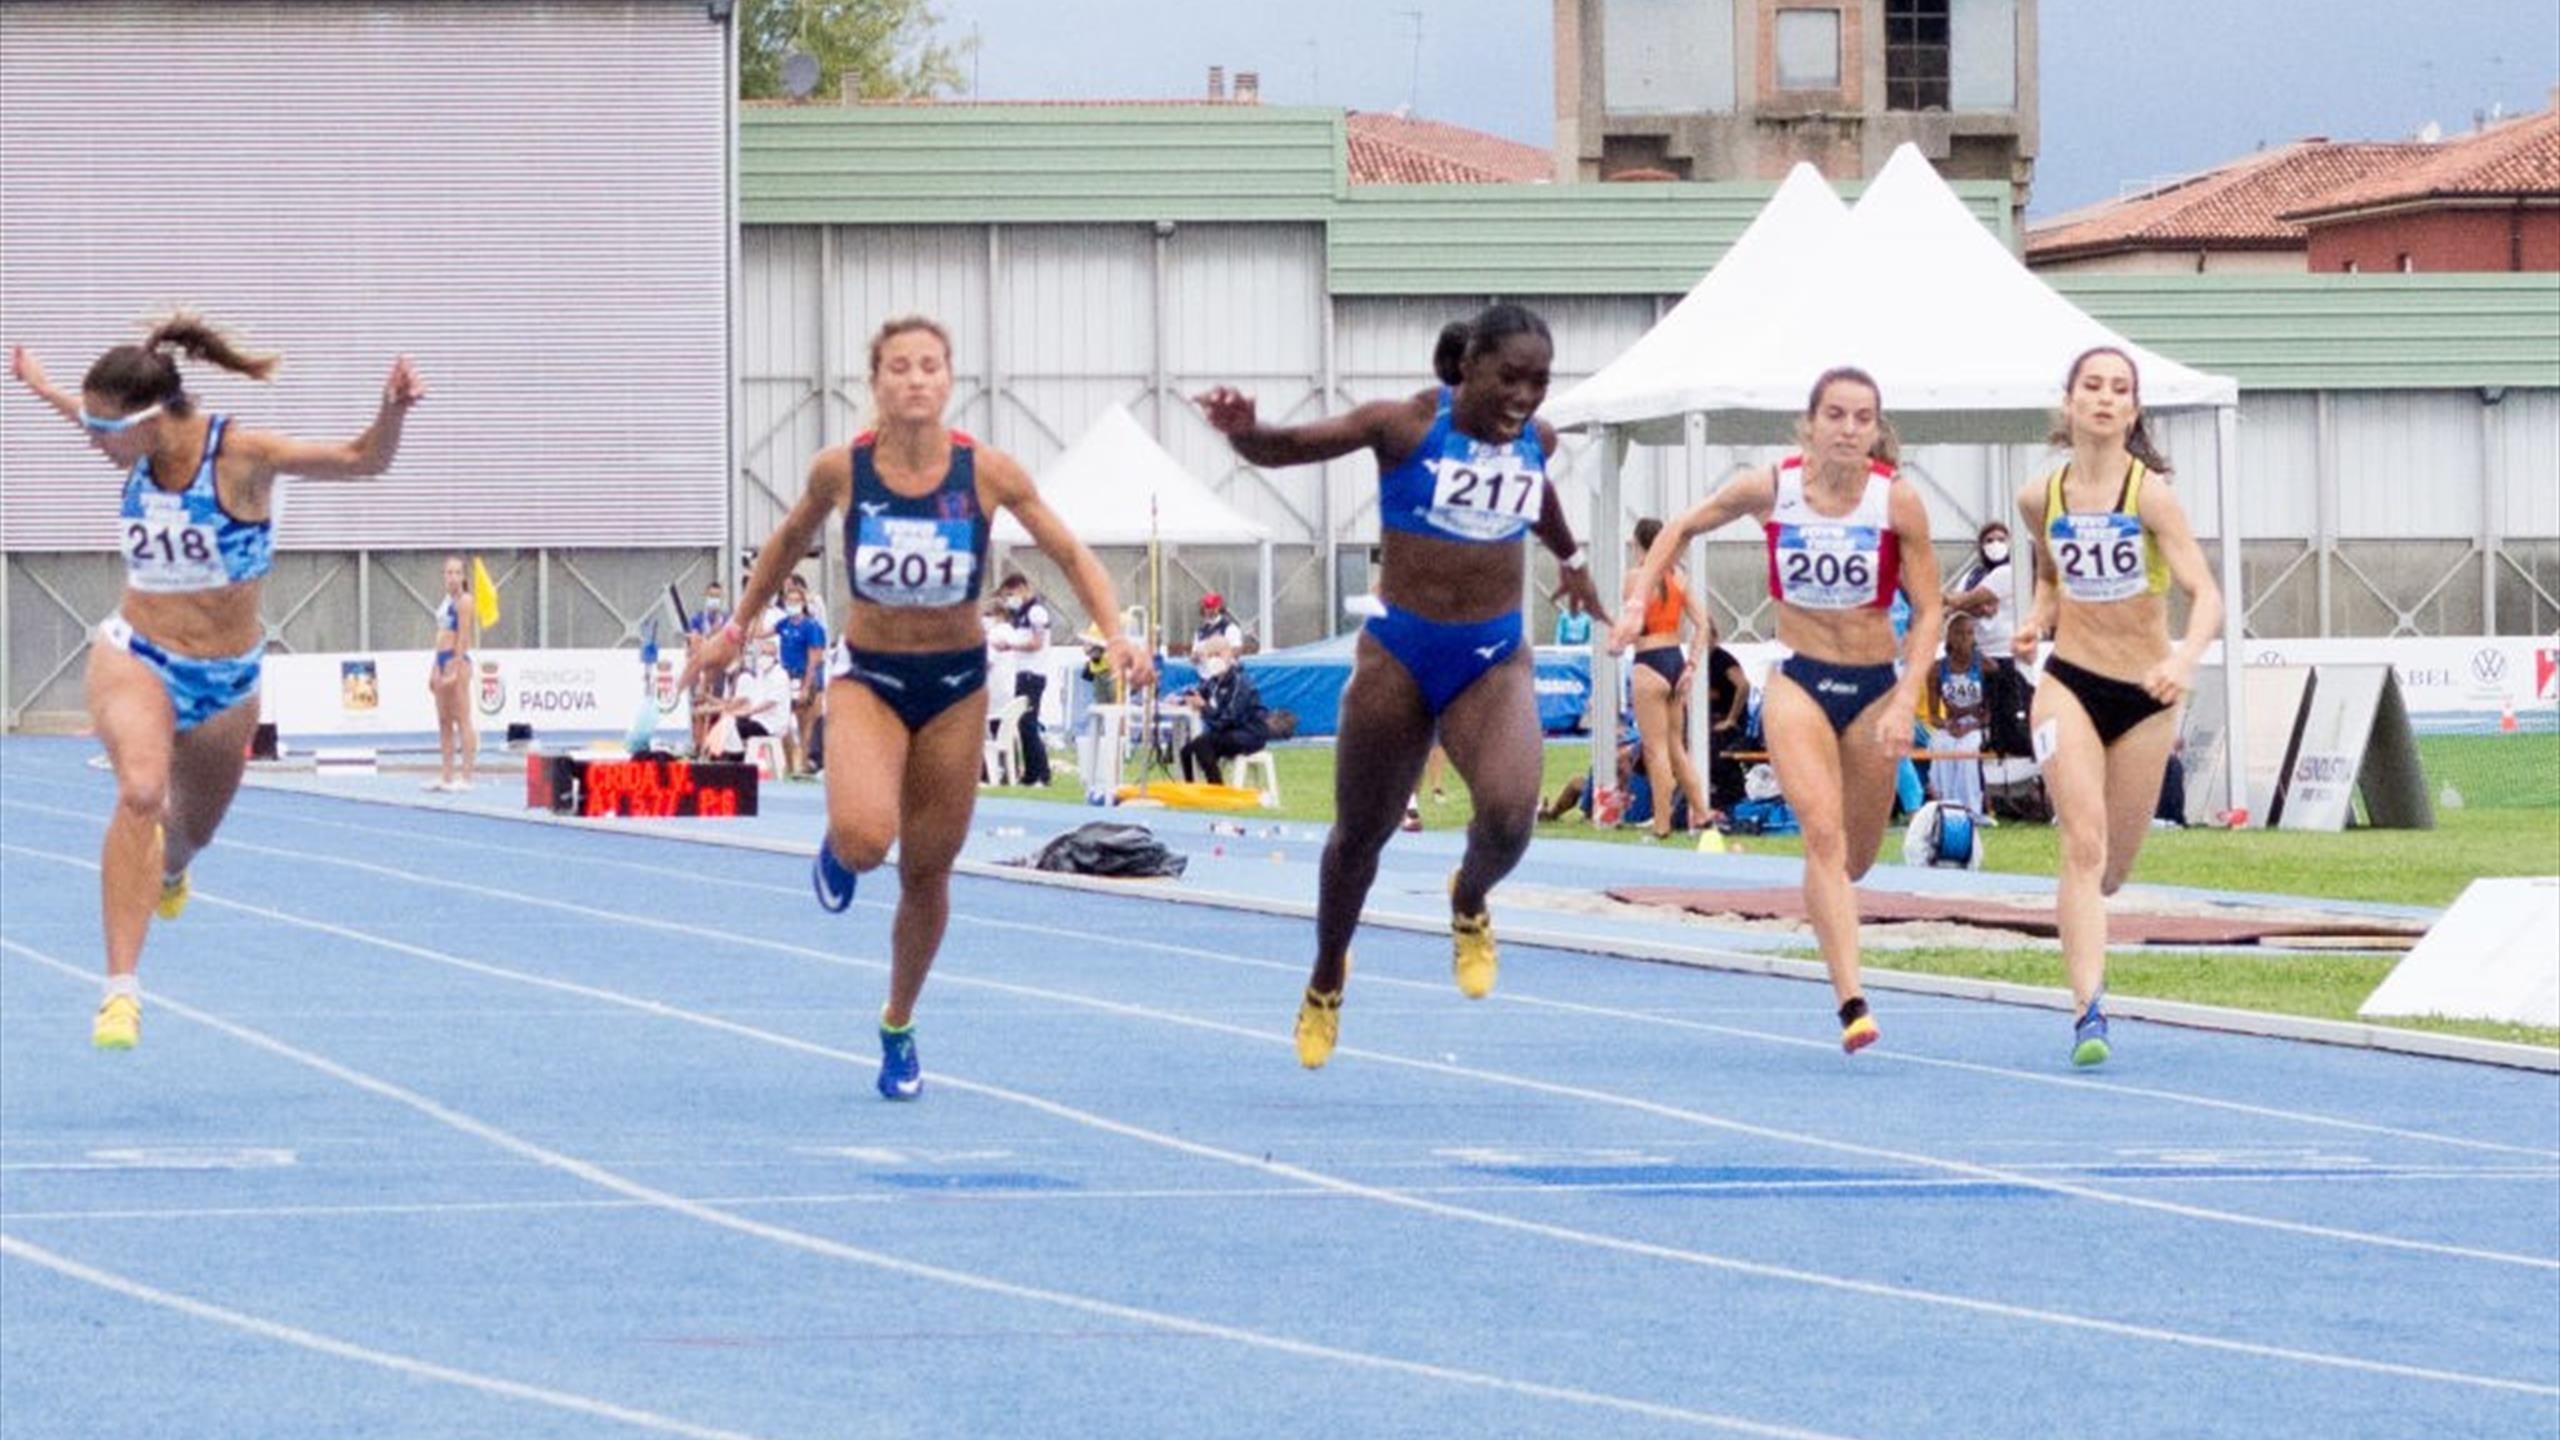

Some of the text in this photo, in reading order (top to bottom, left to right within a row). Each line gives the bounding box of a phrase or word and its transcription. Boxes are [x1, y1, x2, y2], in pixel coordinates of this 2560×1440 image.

[1447, 468, 1534, 513] 217
[128, 524, 210, 562] 218
[2061, 541, 2137, 576] 216
[869, 553, 954, 587] 201
[1787, 553, 1869, 587] 206
[520, 690, 597, 711] PADOVA
